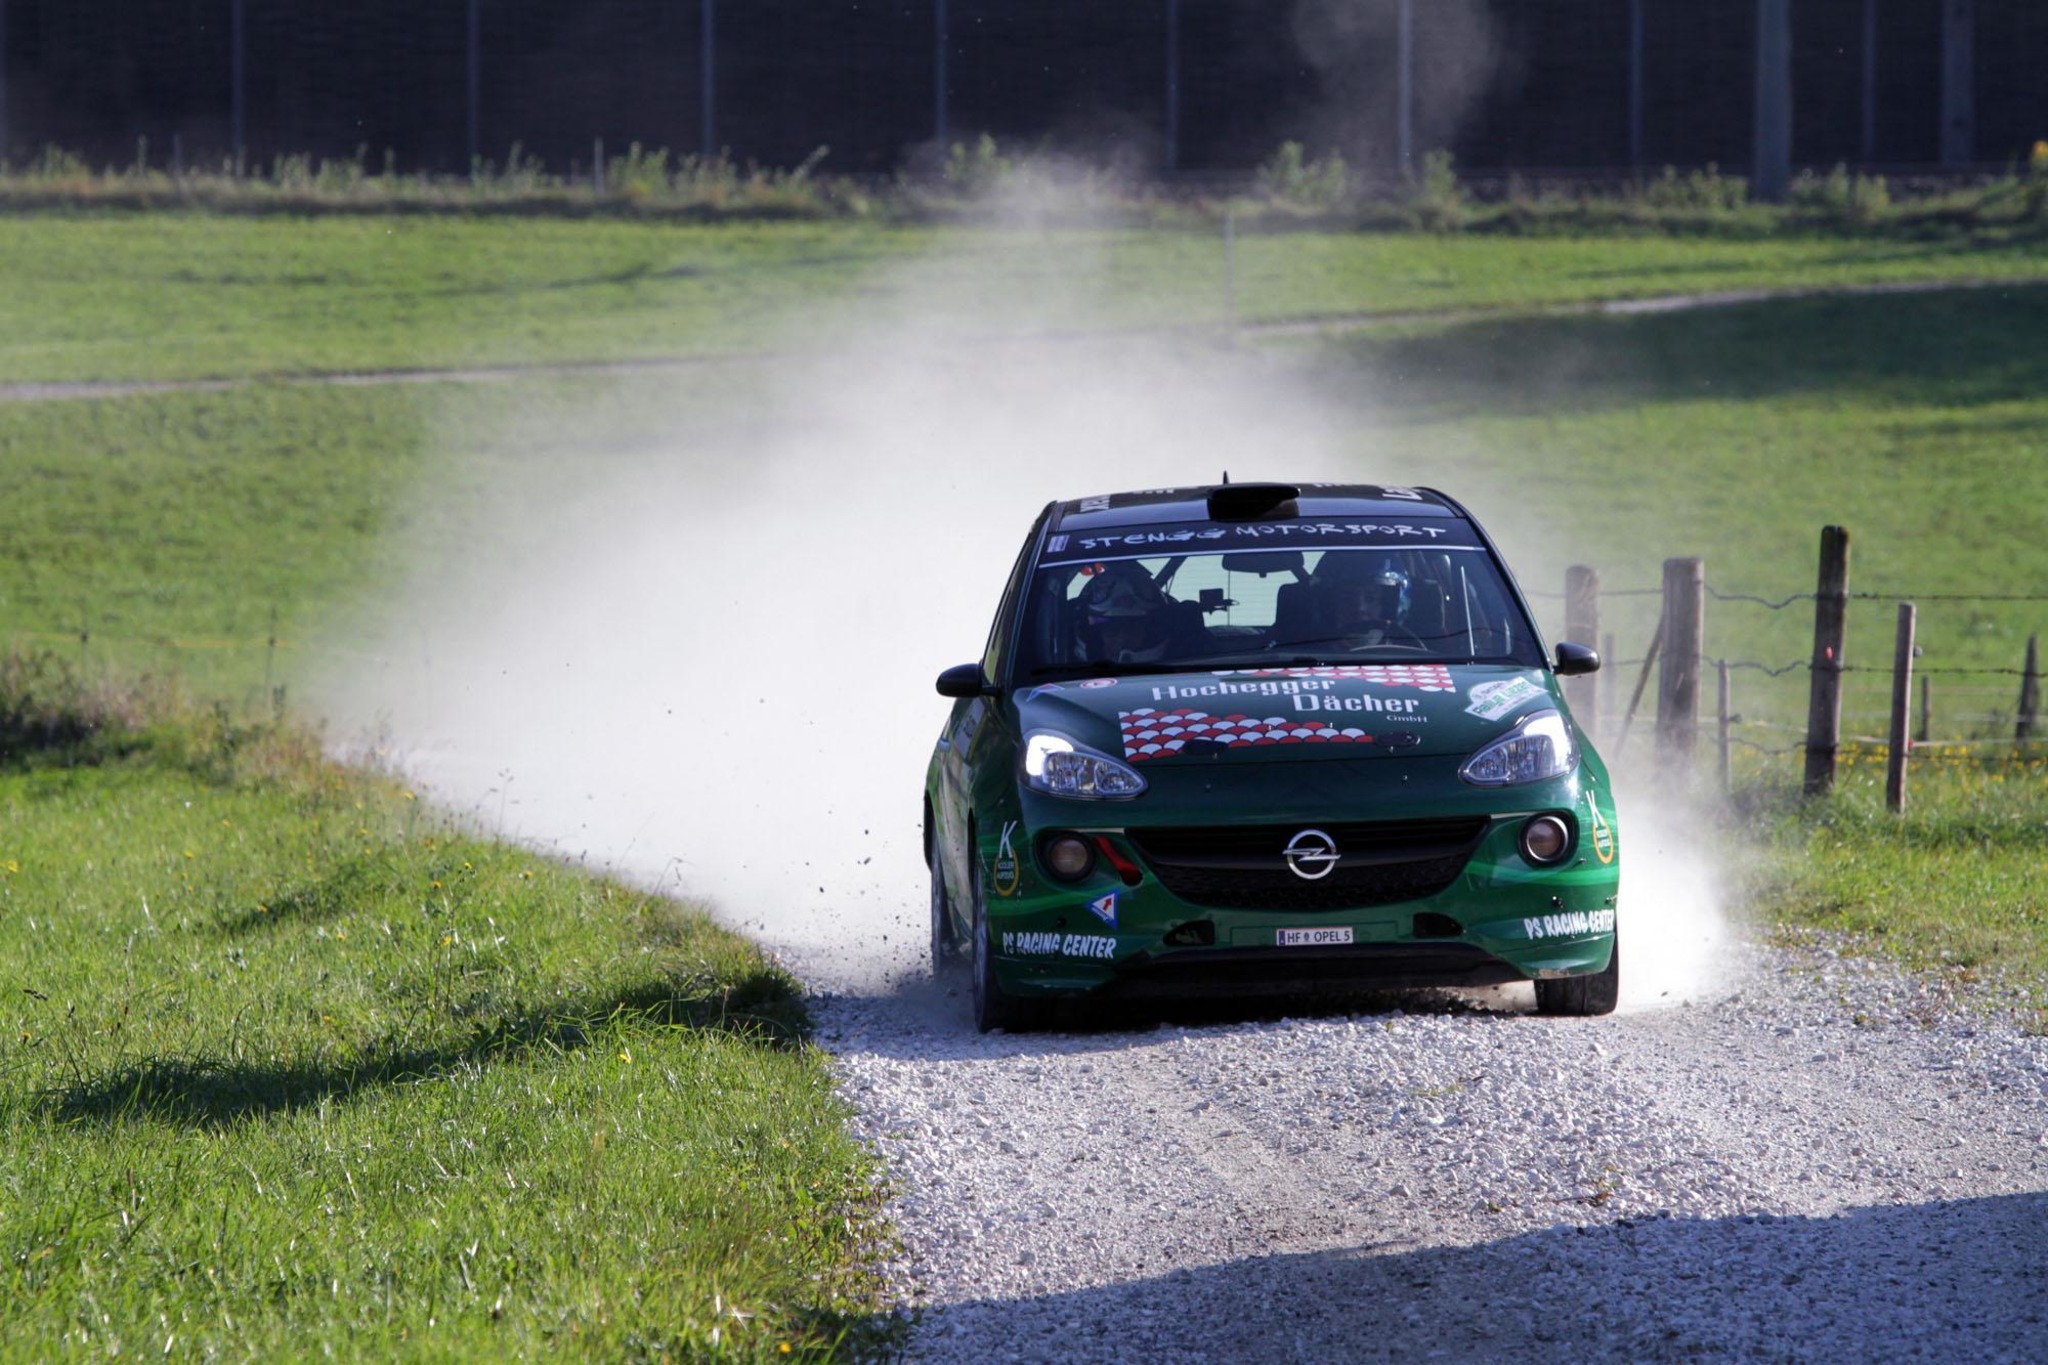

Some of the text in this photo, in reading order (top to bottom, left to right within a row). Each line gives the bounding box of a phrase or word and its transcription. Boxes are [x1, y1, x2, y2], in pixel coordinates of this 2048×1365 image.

[1235, 523, 1446, 538] MOTORSPORT
[1152, 679, 1335, 700] Hochegger
[1293, 694, 1419, 712] Dächer
[1386, 714, 1427, 723] GmbH
[1524, 917, 1544, 940] PS
[1543, 911, 1588, 937] RACING
[1314, 930, 1342, 943] OPEL
[1344, 930, 1351, 942] 5
[1062, 933, 1117, 959] CENTER
